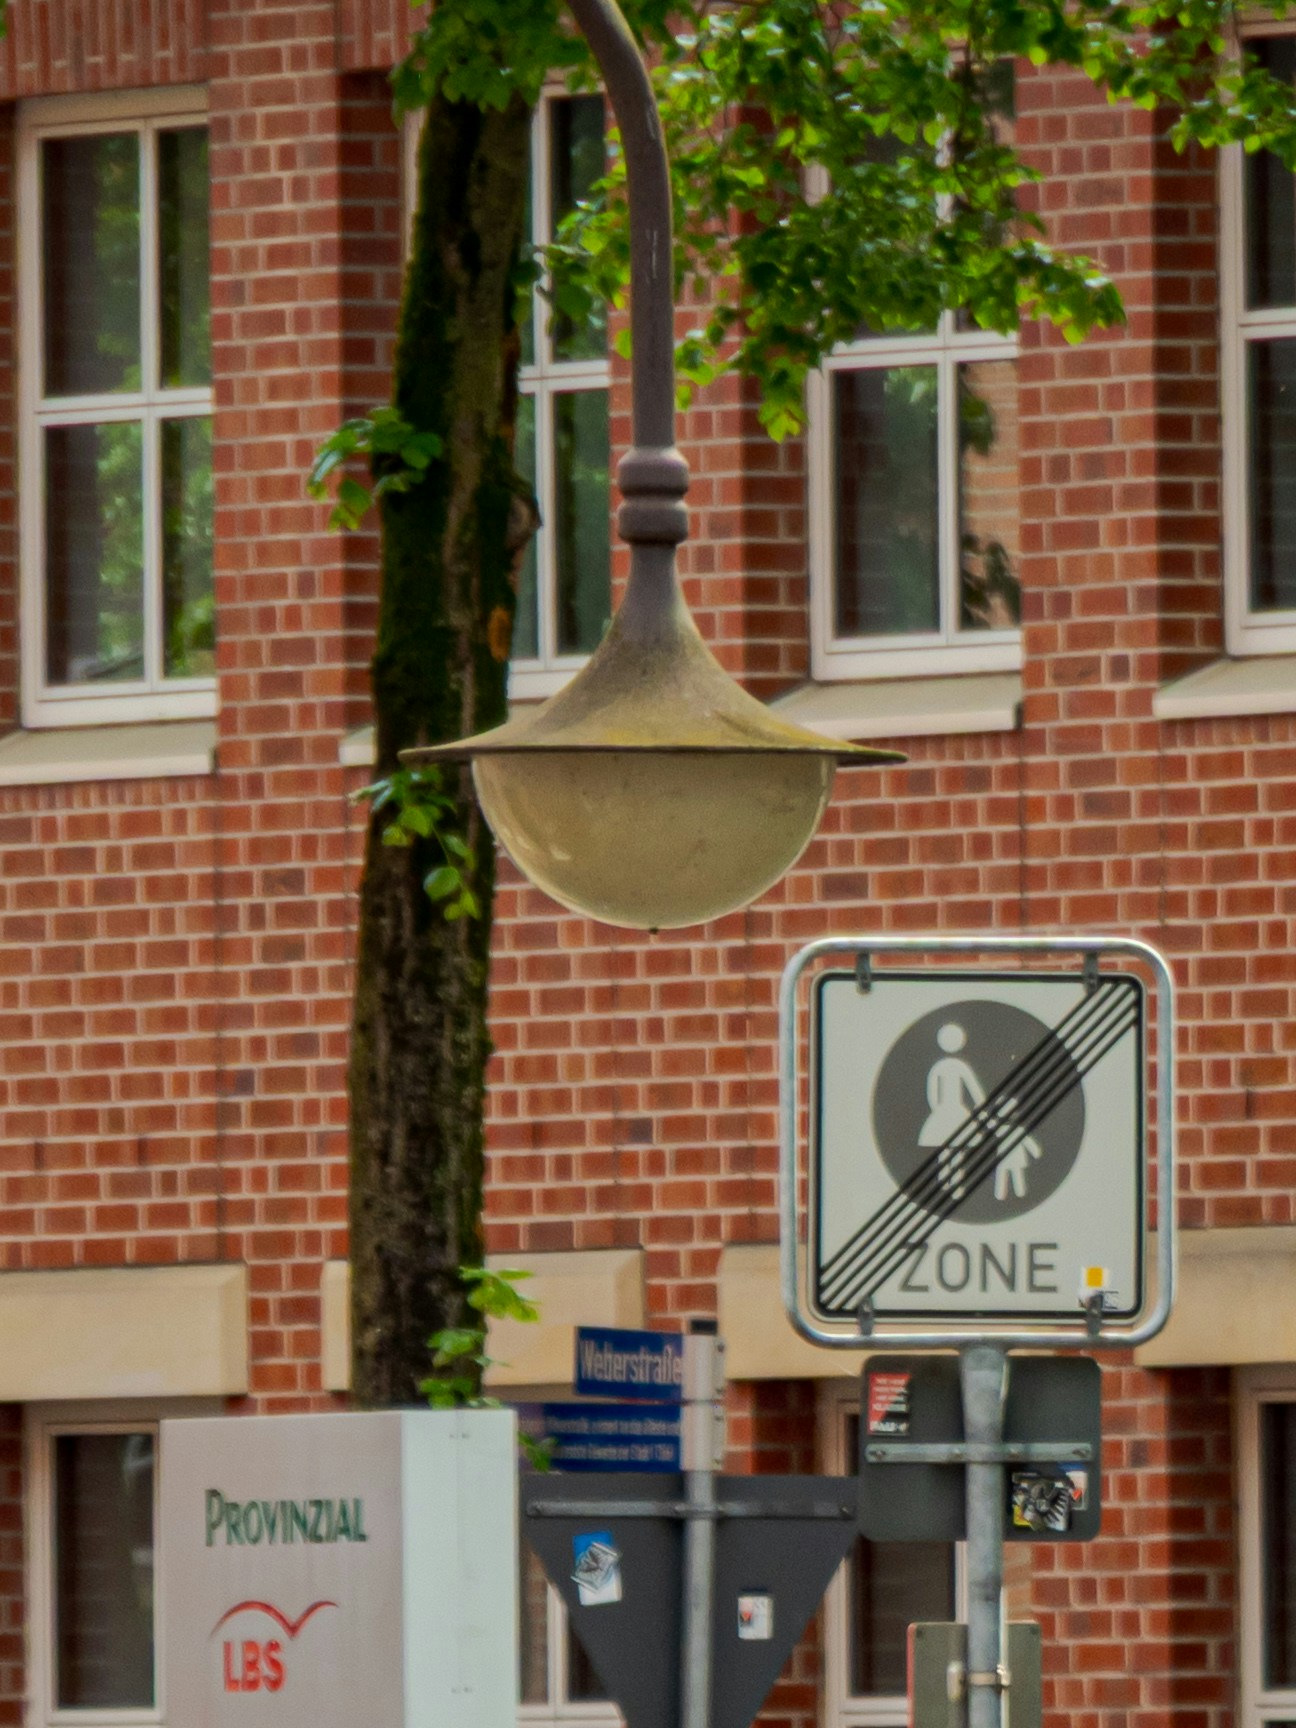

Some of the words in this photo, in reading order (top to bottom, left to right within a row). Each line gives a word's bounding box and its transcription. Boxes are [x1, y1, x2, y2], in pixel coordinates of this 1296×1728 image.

[898, 1241, 1058, 1293] ZONE
[578, 1338, 682, 1384] Weberstraße
[222, 1639, 286, 1693] LBS
